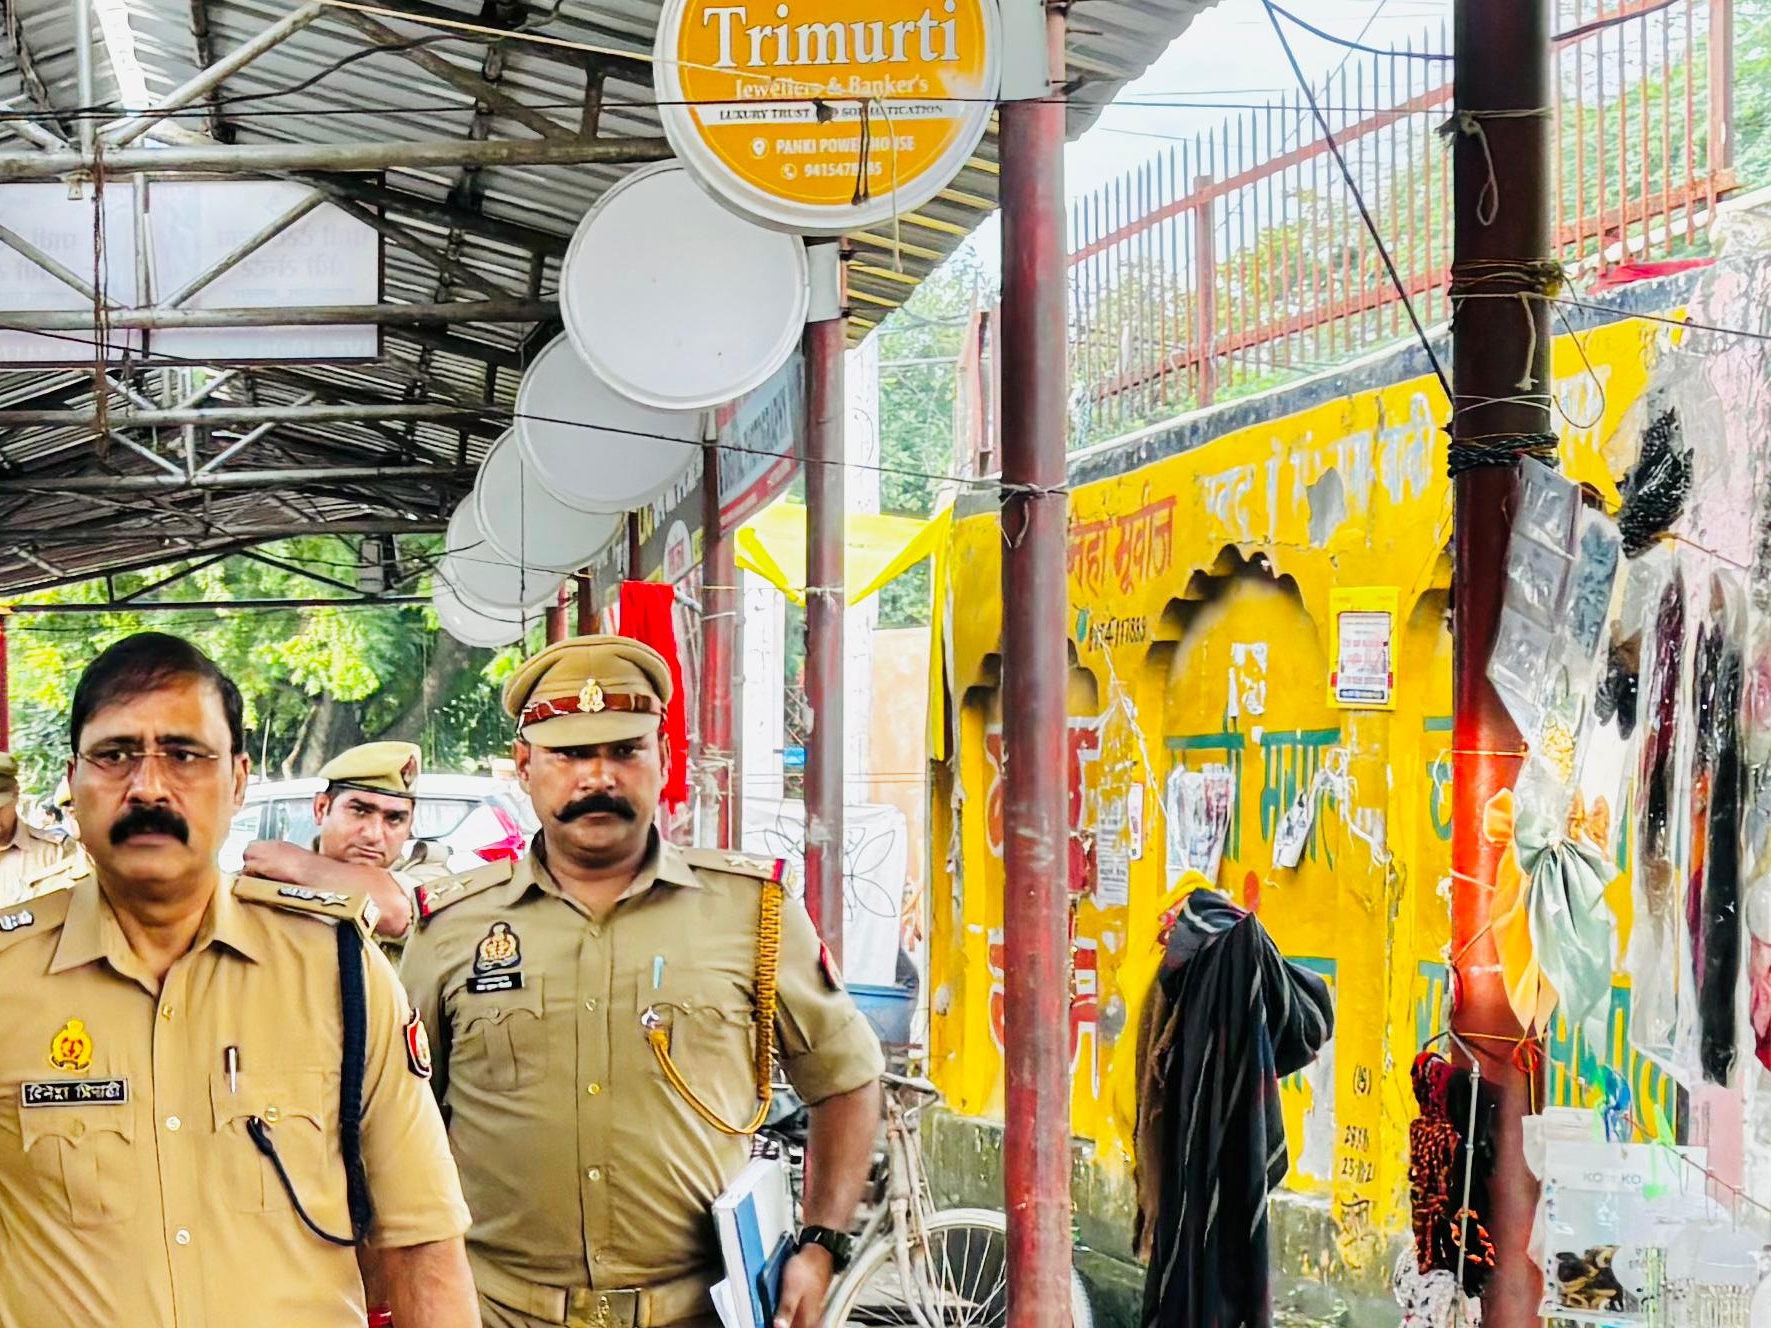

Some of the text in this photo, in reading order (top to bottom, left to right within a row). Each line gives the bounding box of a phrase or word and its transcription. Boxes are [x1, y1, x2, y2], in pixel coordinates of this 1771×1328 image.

[703, 0, 960, 67] Trimurti
[827, 76, 843, 96] &
[720, 108, 767, 120] LUXURY
[770, 107, 810, 119] TRUST
[775, 137, 817, 154] PANKI
